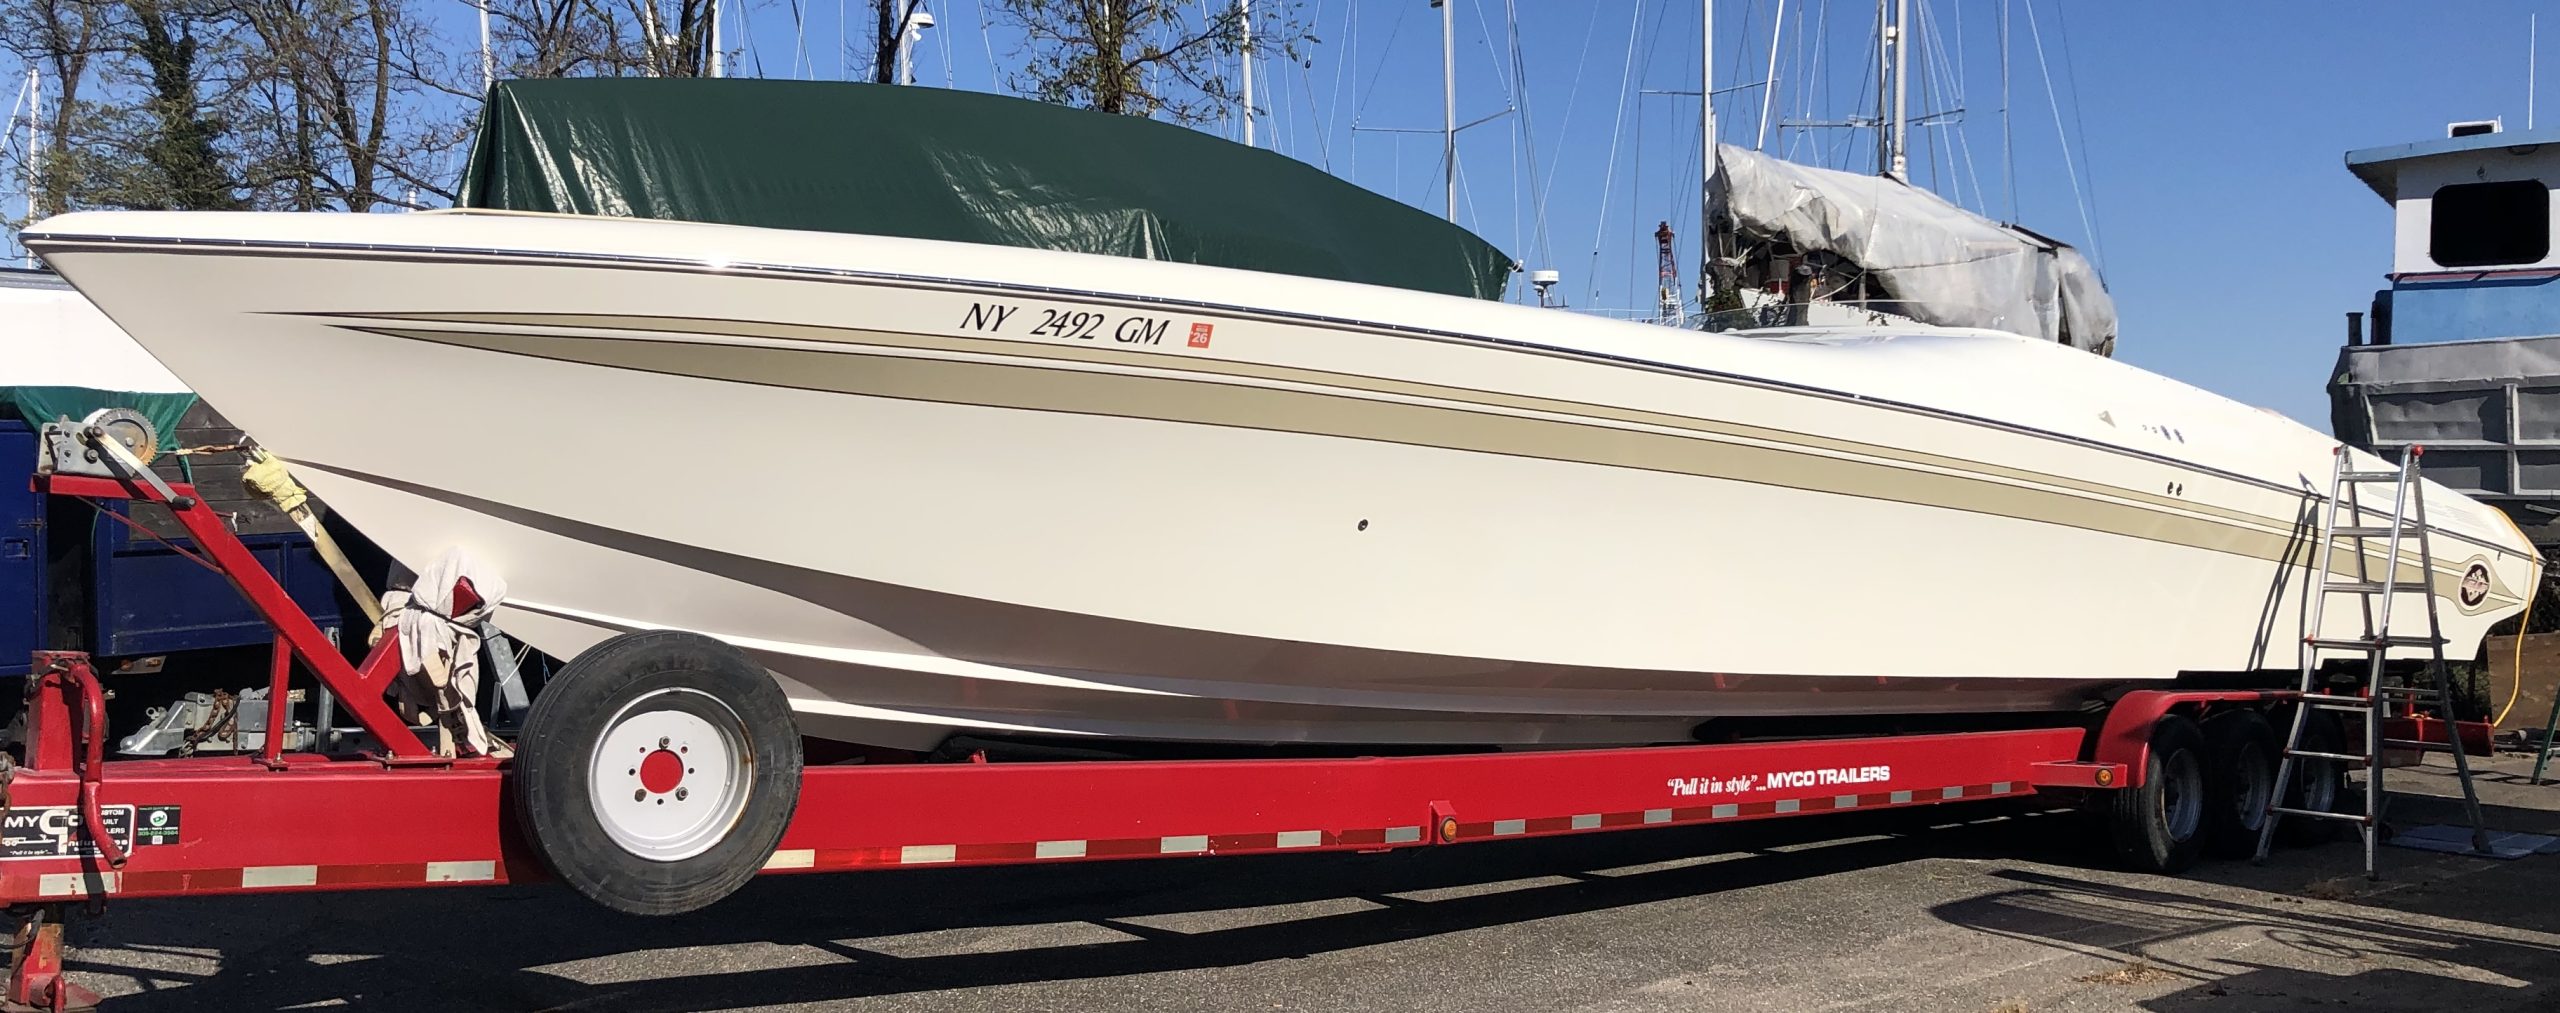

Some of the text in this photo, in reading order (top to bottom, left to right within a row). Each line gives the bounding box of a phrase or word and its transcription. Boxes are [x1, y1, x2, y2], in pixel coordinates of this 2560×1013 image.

[959, 303, 1171, 345] NY 2492 GM
[1699, 777, 1709, 795] it
[1710, 776, 1723, 794] in
[1767, 771, 1815, 789] MYCO
[1816, 766, 1891, 785] TRAILERS
